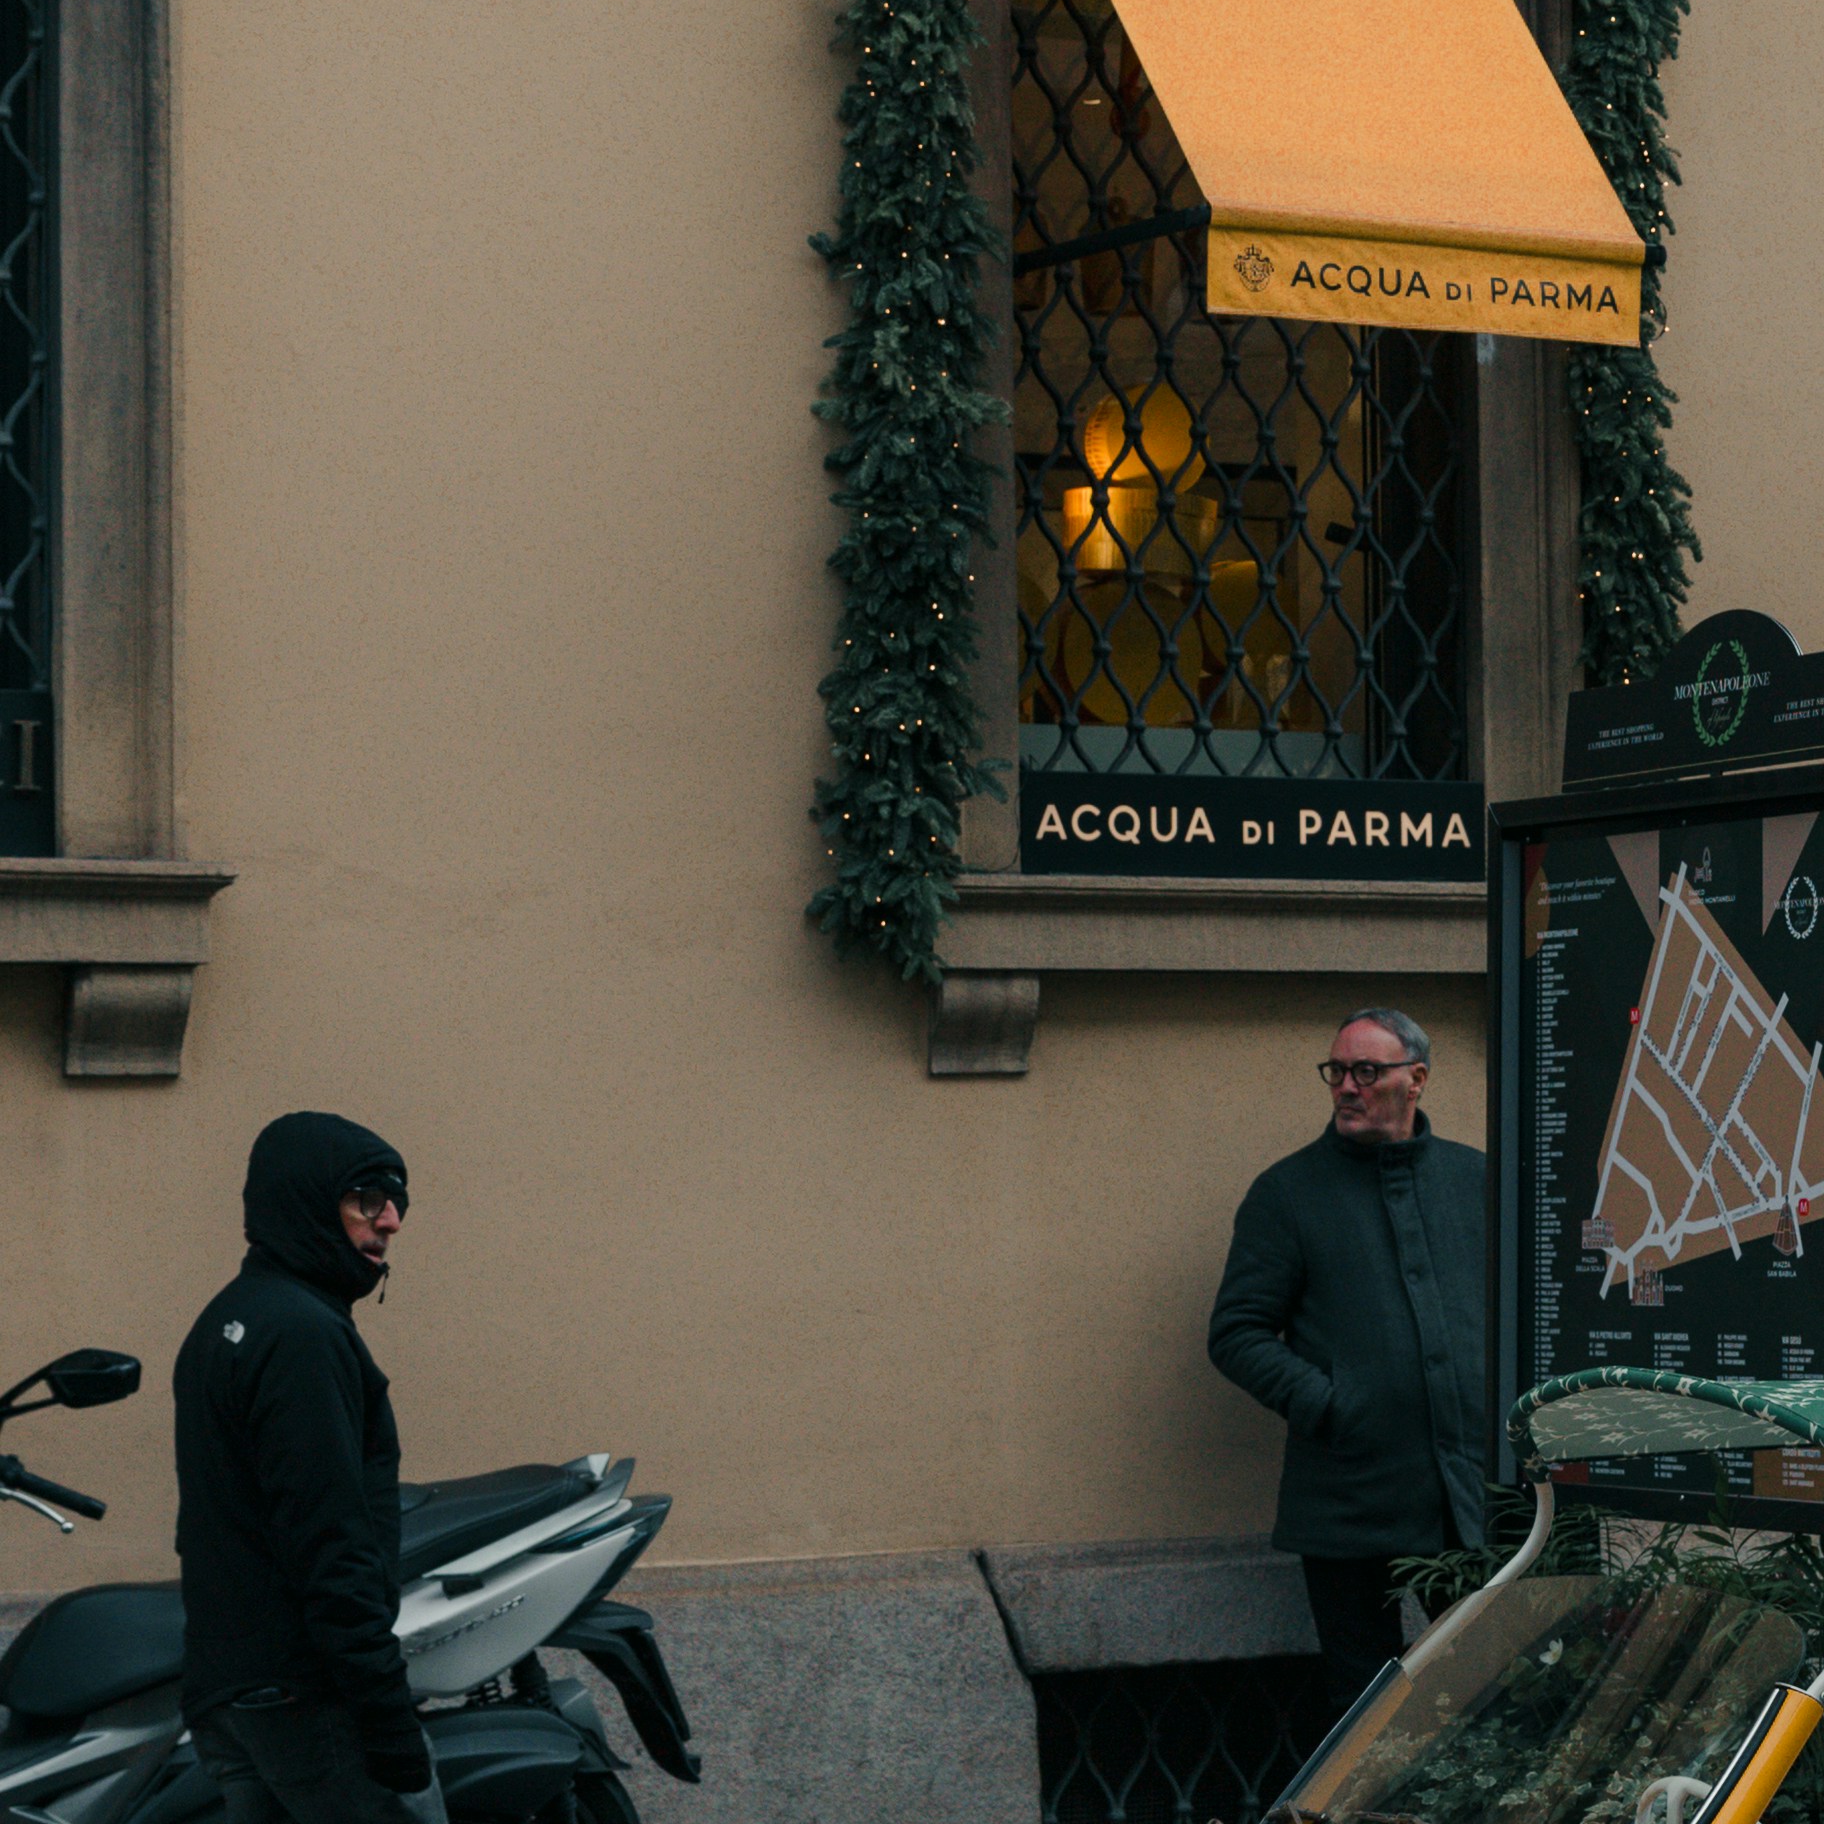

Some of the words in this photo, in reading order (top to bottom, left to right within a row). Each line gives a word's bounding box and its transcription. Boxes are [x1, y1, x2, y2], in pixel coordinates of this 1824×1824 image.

[1290, 260, 1431, 298] ACQUA
[1445, 280, 1473, 303] DI
[1491, 276, 1619, 315] PARMA
[1673, 670, 1771, 701] MONTENAPOLEONE
[1034, 803, 1216, 846] ACQUA
[1241, 819, 1276, 846] DI
[1299, 808, 1472, 848] PARMA
